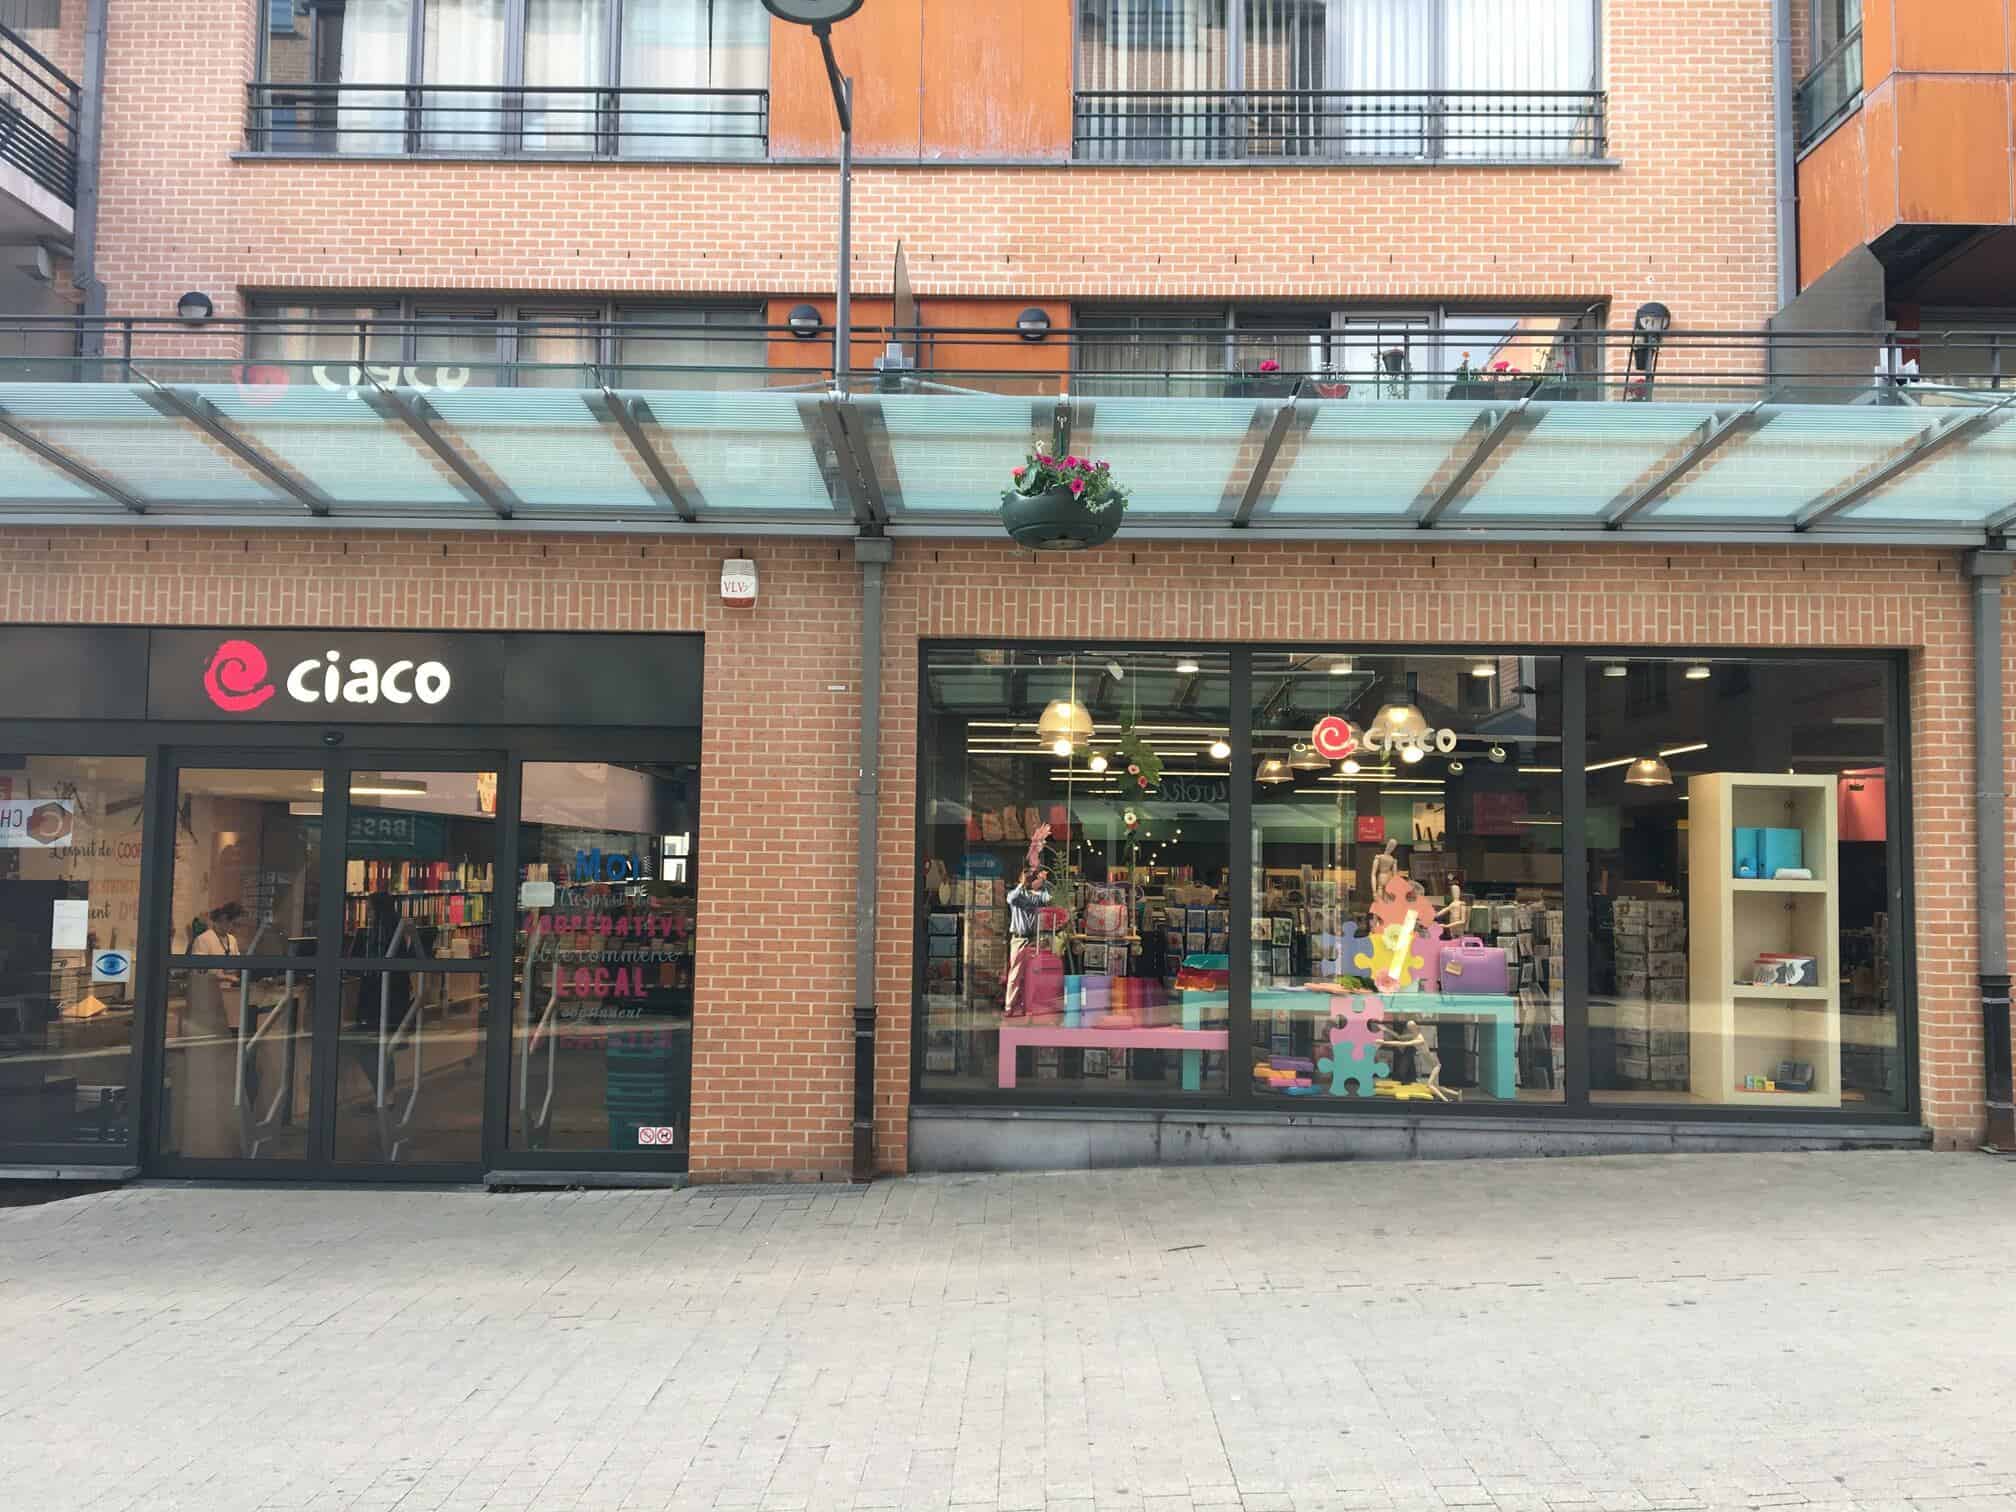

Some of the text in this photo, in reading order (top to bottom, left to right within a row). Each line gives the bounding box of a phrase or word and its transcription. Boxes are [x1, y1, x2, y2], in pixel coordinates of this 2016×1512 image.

[286, 649, 451, 704] ciaco
[1362, 721, 1457, 753] ciaco
[556, 966, 649, 998] LOCAL
